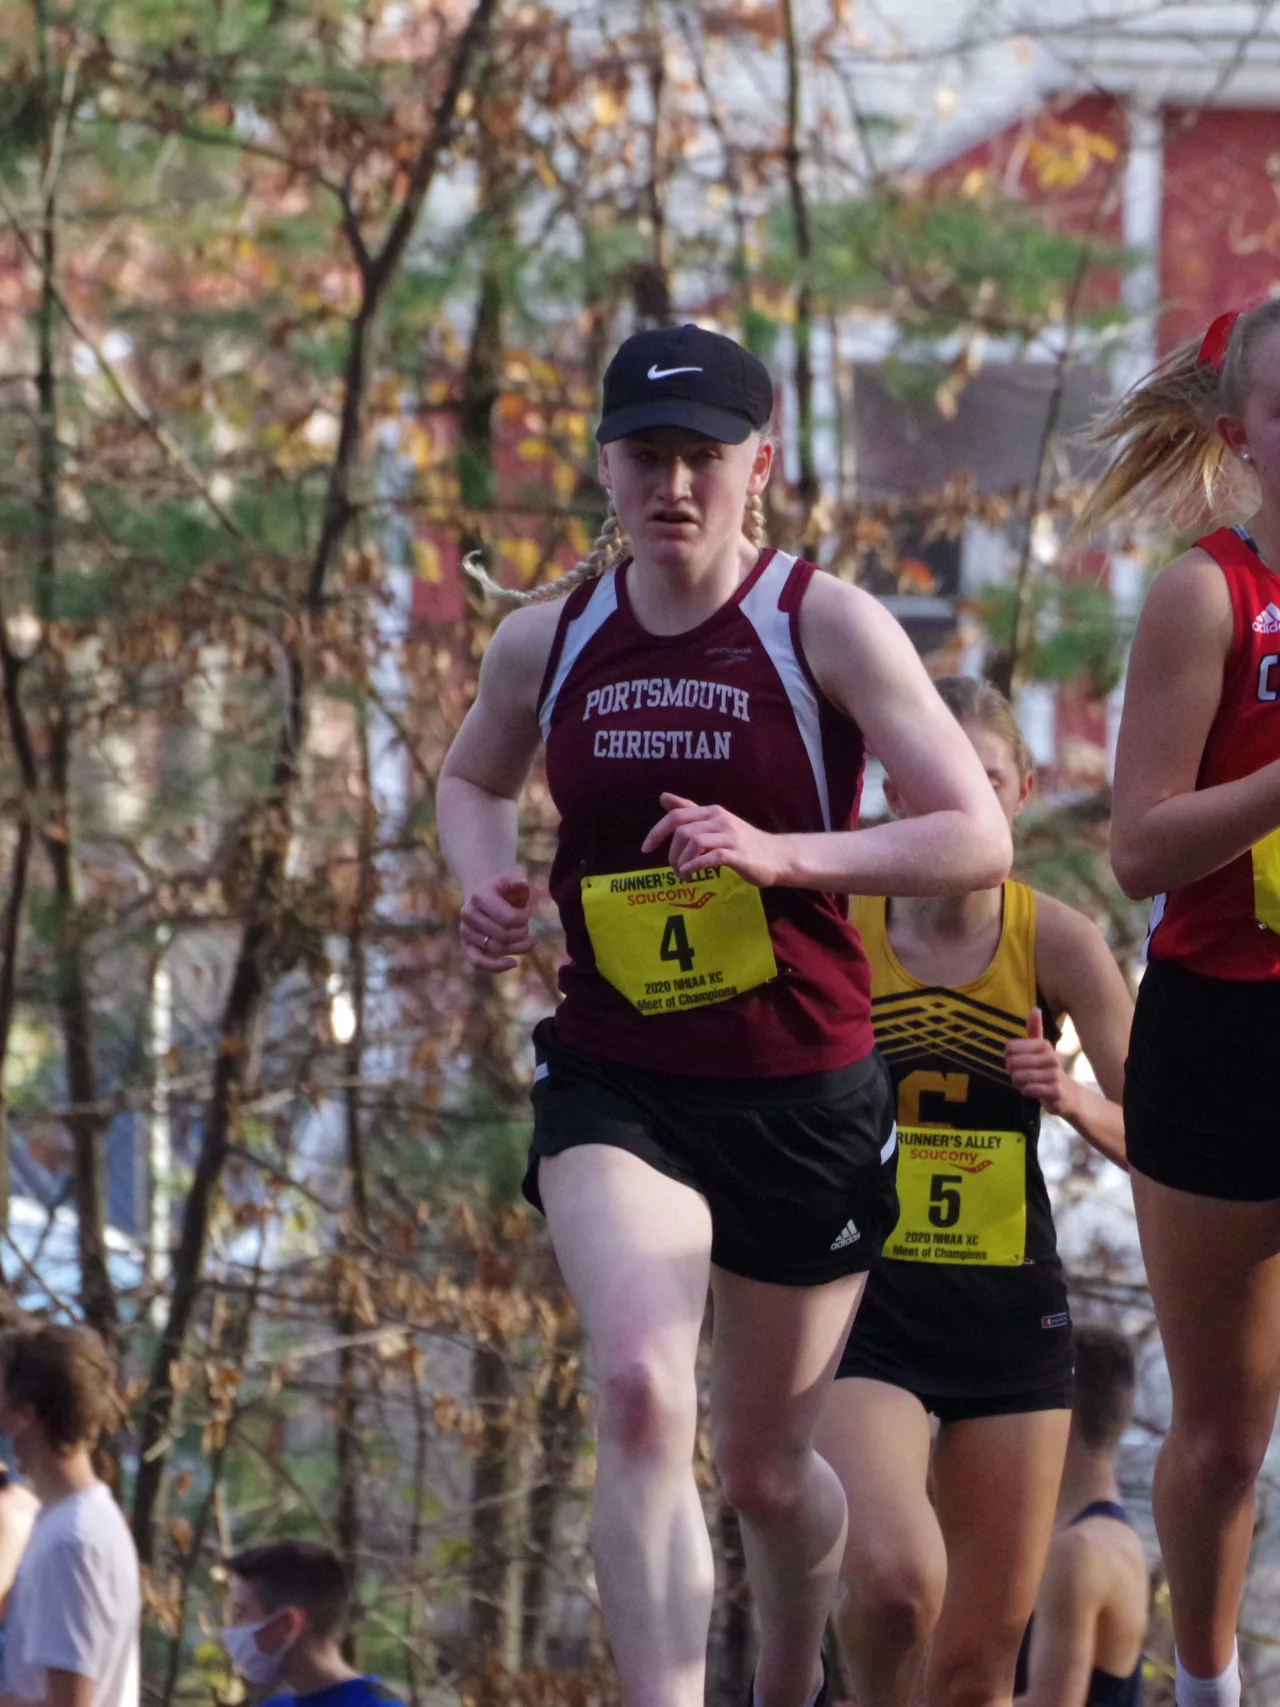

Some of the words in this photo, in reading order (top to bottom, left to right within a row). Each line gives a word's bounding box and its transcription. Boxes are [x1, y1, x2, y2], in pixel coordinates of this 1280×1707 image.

[582, 678, 750, 722] PORTSMOUTH
[593, 730, 732, 760] CHRISTIAN
[610, 872, 677, 893] RUNNER'S
[680, 866, 722, 884] LEY
[627, 886, 697, 906] saucony
[660, 914, 695, 973] 4
[645, 980, 672, 995] 2020
[673, 975, 706, 992] NHIAA
[708, 971, 724, 984] XC
[637, 998, 663, 1011] Meet
[666, 995, 676, 1009] of
[678, 986, 738, 1006] Champions
[896, 1132, 963, 1148] RUNNER'S
[965, 1136, 1002, 1149] ALLEY
[910, 1148, 978, 1166] saucony
[928, 1174, 963, 1228] 5
[830, 1232, 861, 1250] adidas
[904, 1231, 931, 1243] 2020
[966, 1234, 979, 1246] XC
[893, 1245, 919, 1257] Meet
[921, 1247, 931, 1258] of
[934, 1247, 988, 1260] Champions
